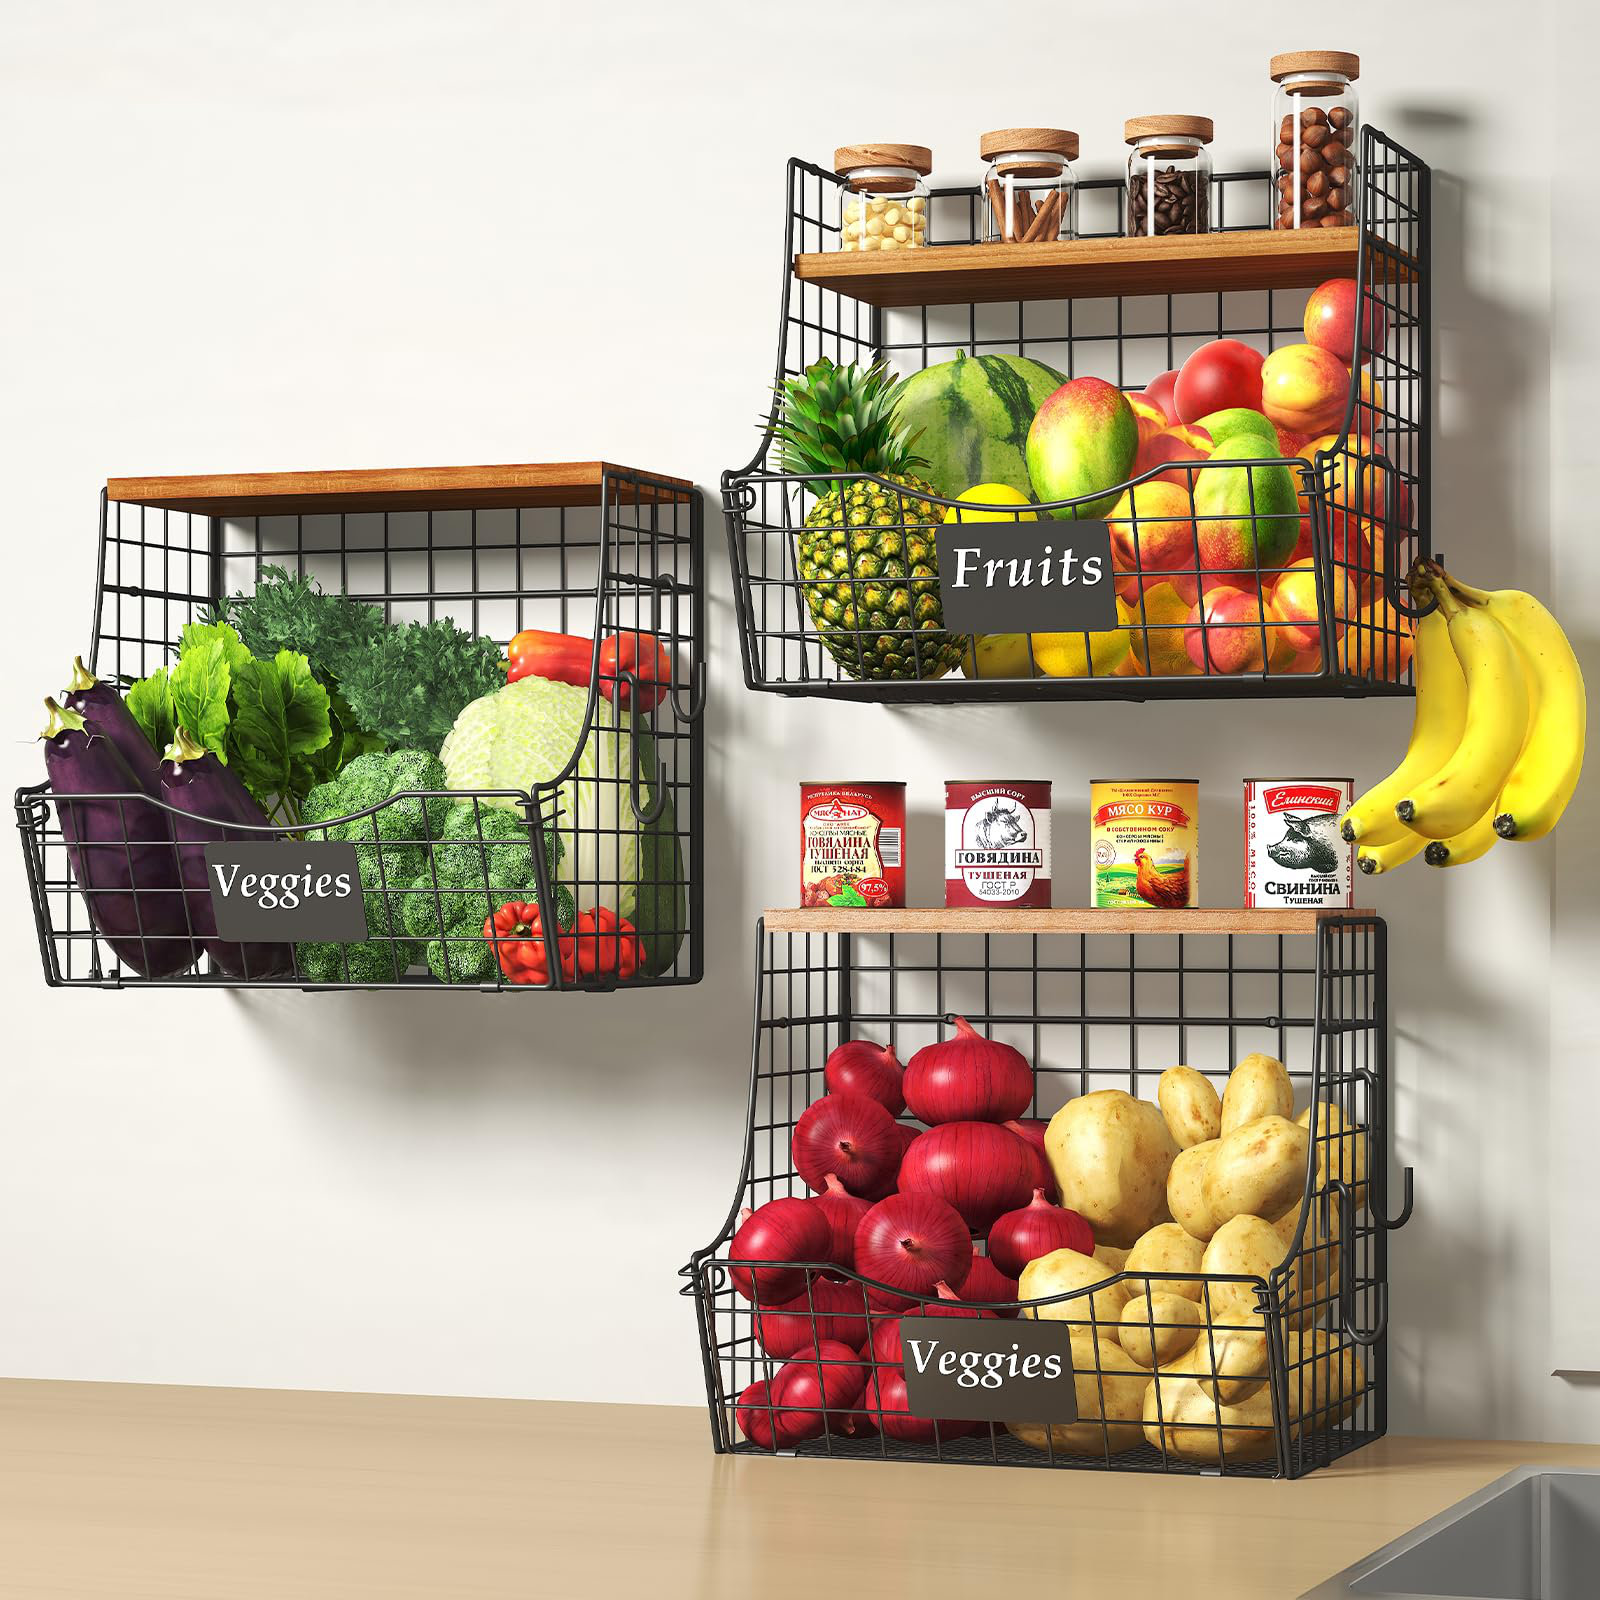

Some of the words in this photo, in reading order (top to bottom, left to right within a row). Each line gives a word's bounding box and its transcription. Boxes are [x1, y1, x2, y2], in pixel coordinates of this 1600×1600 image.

[951, 545, 1103, 588] Fruits
[970, 788, 1006, 801] ВЫСШИЙ
[1007, 789, 1026, 800] СОРТ
[1271, 791, 1334, 808] Елинский
[1107, 804, 1144, 817] МЯСО
[1147, 805, 1172, 816] КУР
[808, 837, 871, 849] ГОВЯДИНА
[810, 848, 869, 860] ТУШЕНАЯ
[958, 852, 1040, 865] ГОВЯДИНА
[968, 871, 1027, 880] ТУШЕНАЯ
[211, 863, 351, 909] Veggies
[861, 883, 888, 893] 97,5%
[981, 881, 1006, 889] ГОСТ
[1009, 881, 1017, 889] Р
[1264, 881, 1340, 895] СВИНИНА
[906, 1340, 1062, 1389] Veggies
